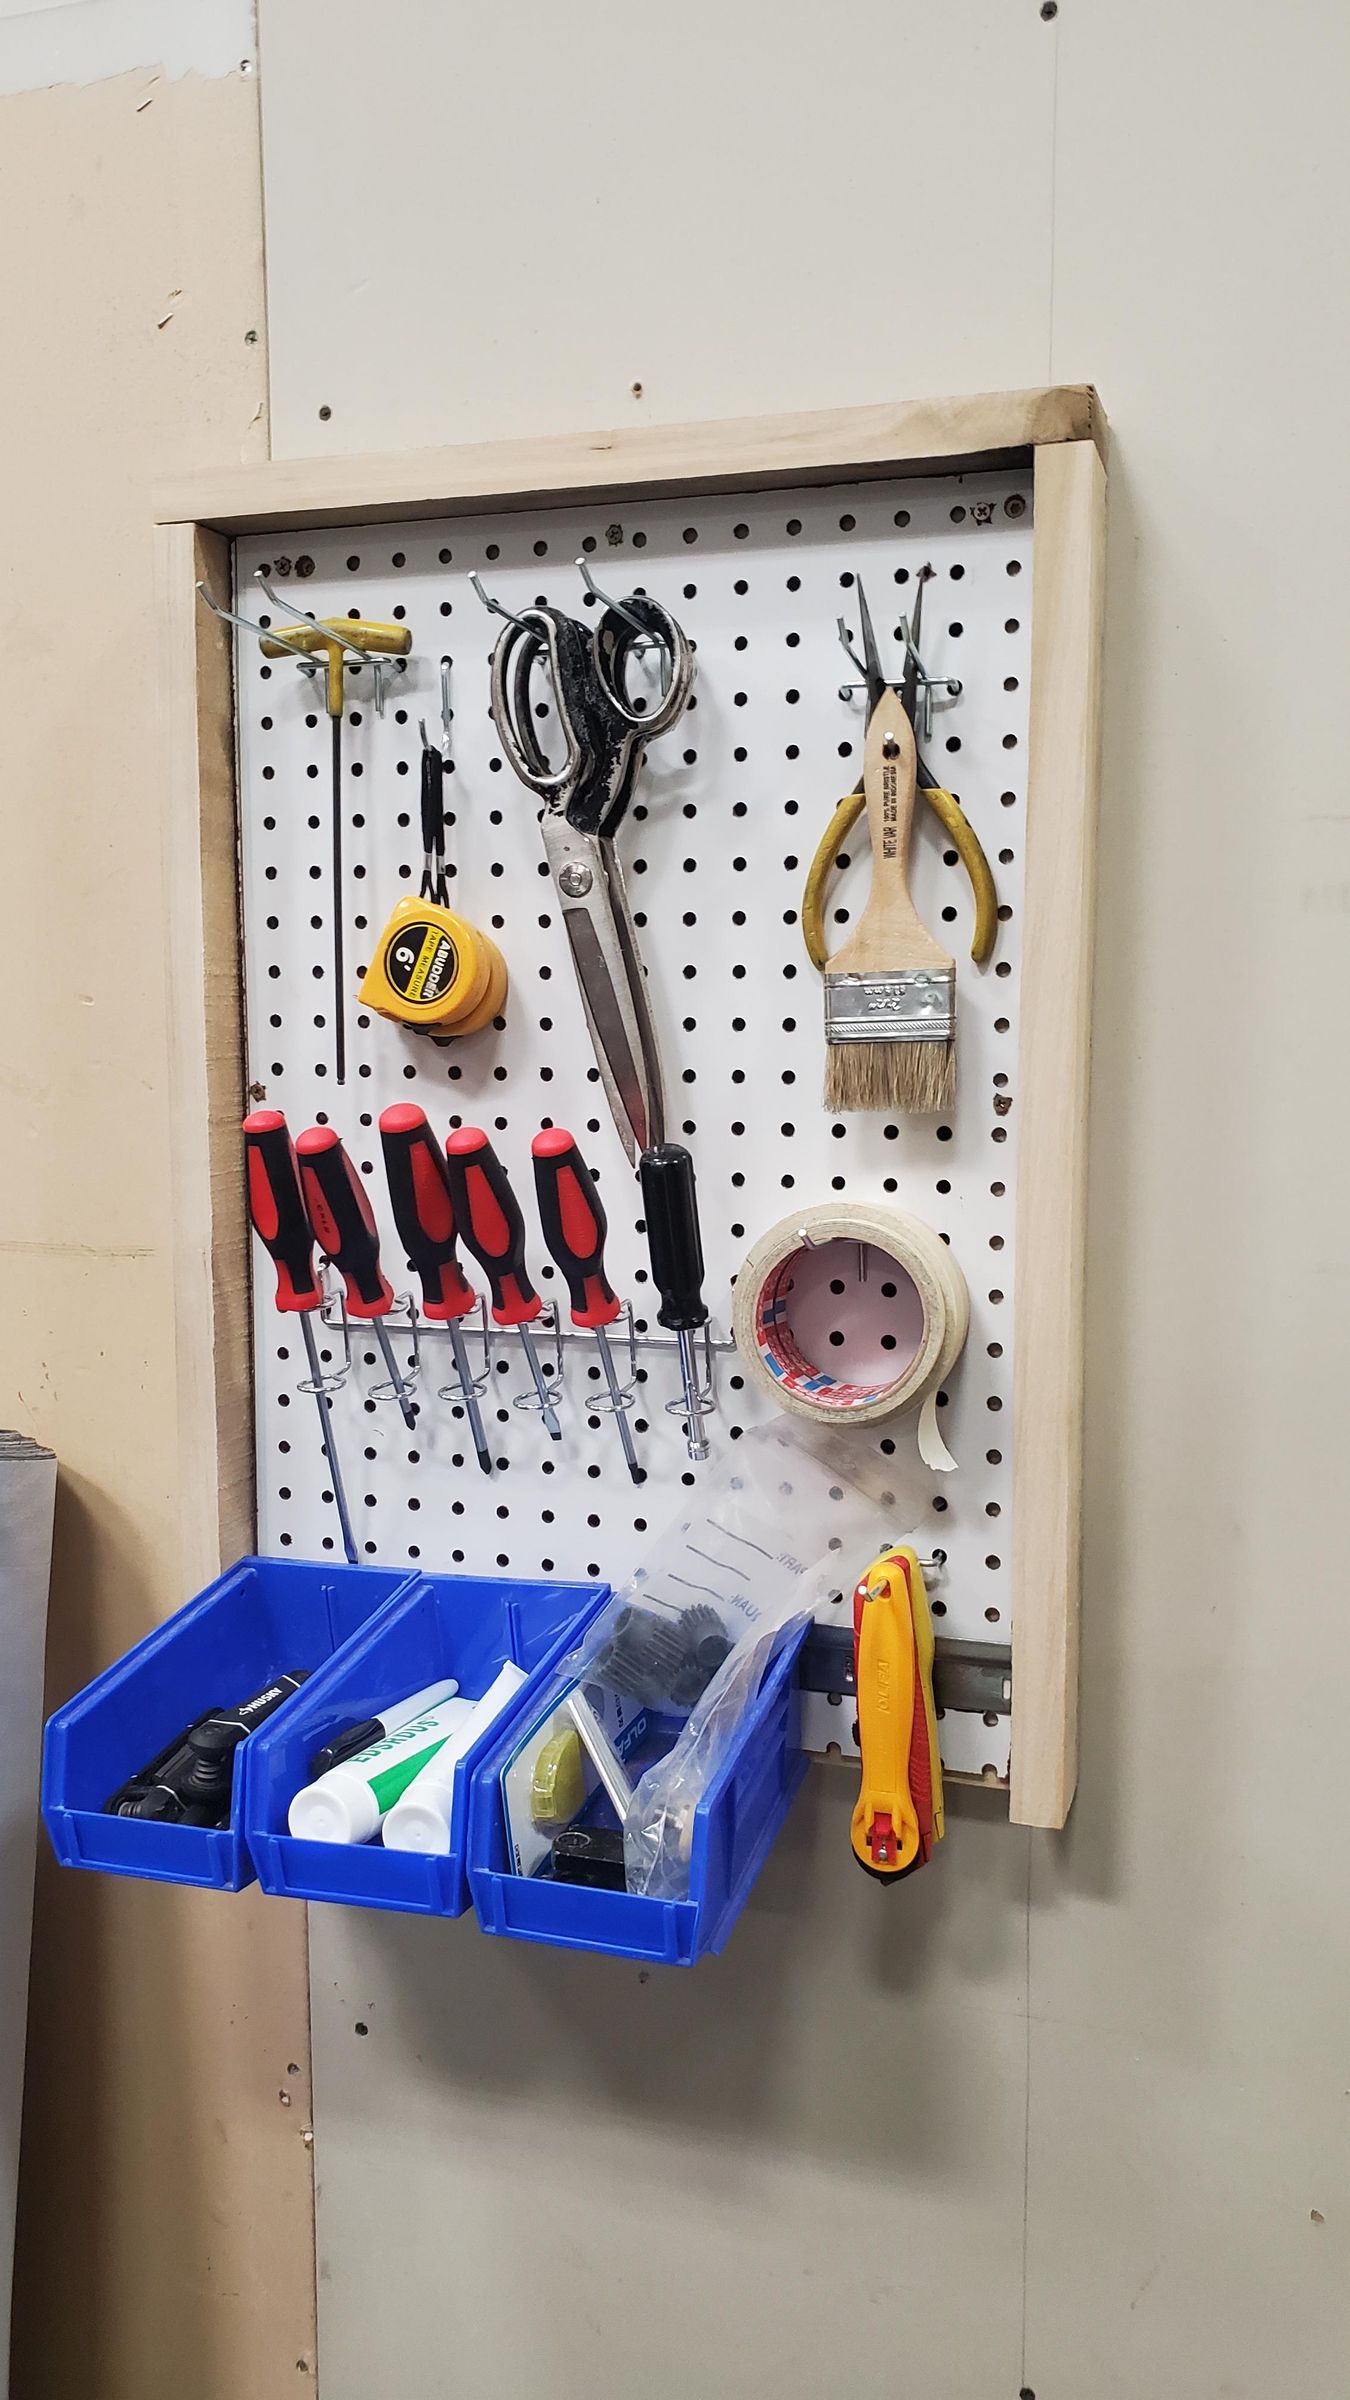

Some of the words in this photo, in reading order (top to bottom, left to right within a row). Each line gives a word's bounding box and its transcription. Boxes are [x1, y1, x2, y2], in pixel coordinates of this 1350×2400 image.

[427, 931, 439, 953] TAPE
[409, 955, 430, 997] MEASURE
[422, 940, 451, 998] ABUDDER
[246, 1686, 283, 1709] HUSKY
